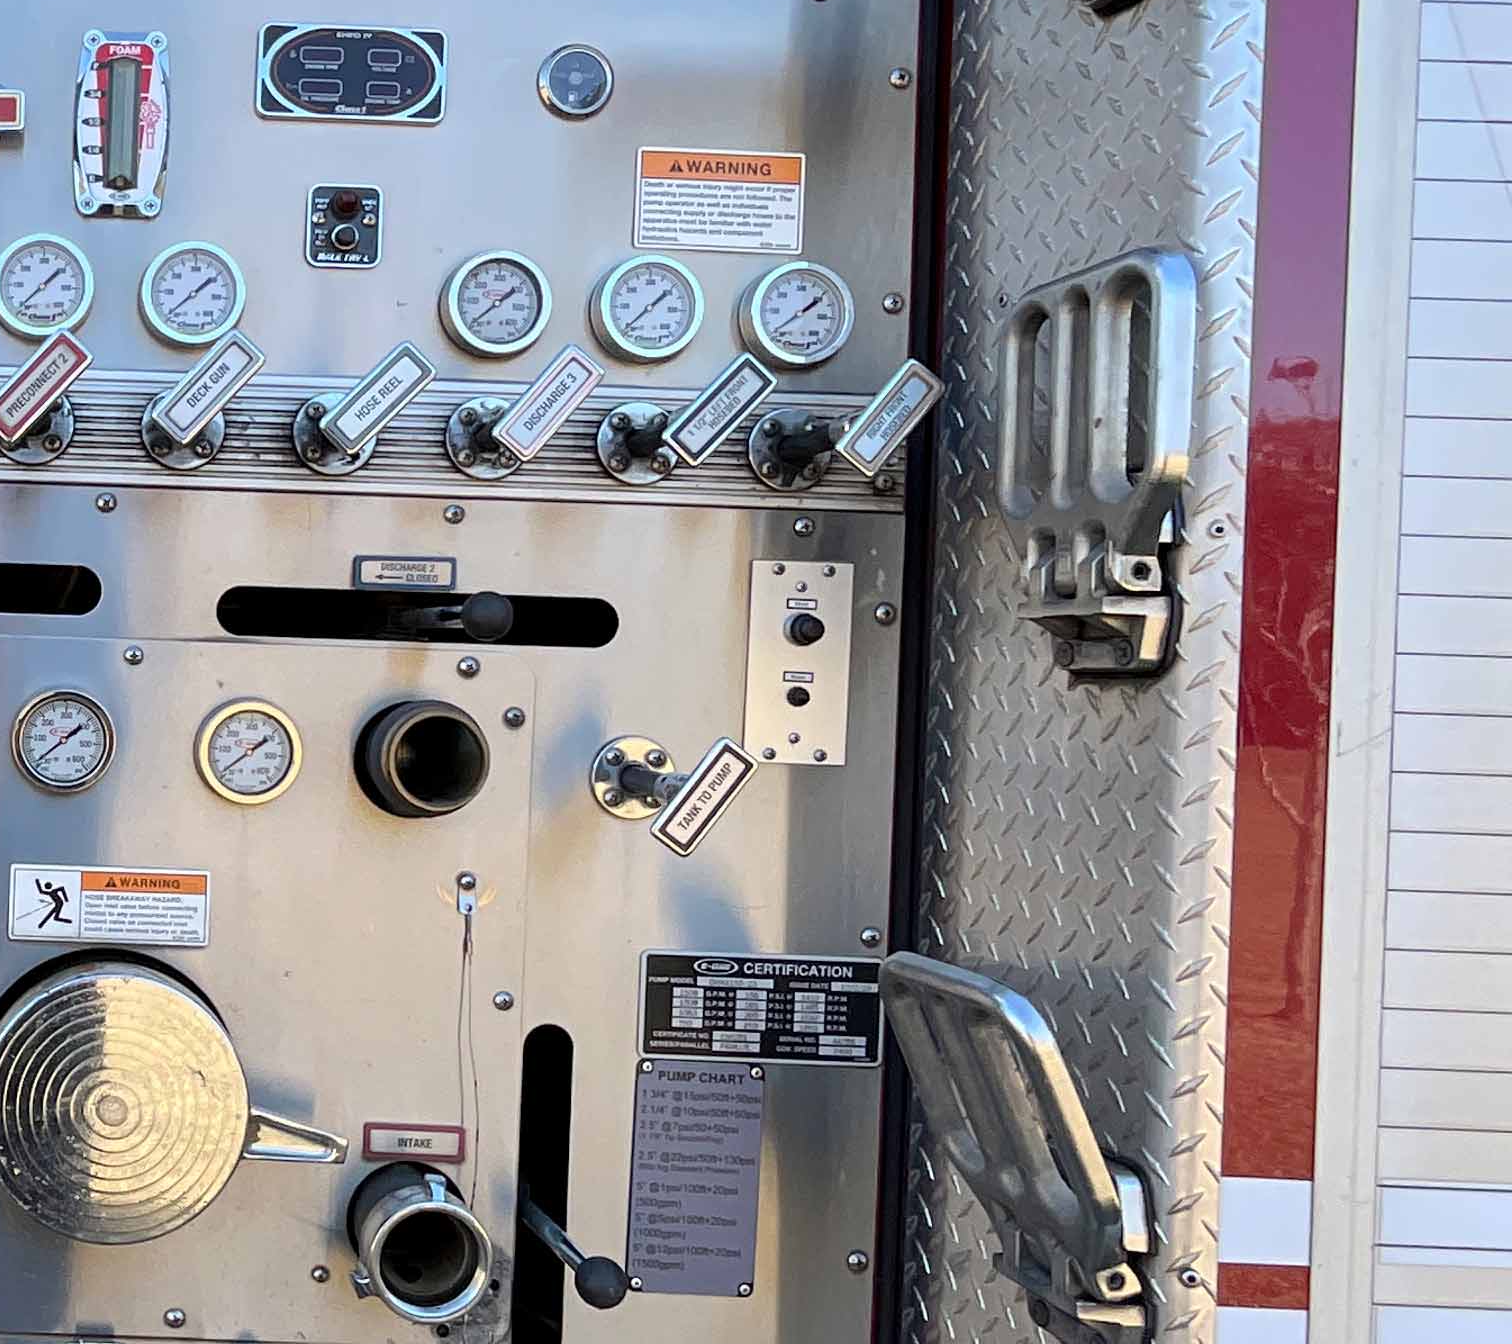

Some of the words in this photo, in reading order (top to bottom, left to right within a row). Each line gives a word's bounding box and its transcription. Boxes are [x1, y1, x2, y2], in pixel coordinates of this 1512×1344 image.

[109, 45, 141, 56] FOAM
[687, 159, 772, 177] WARNING
[6, 363, 61, 418] PRECONNECT
[186, 380, 212, 409] DECK
[207, 362, 231, 386] GUN
[354, 395, 382, 422] HOSE
[378, 375, 404, 399] REEL
[707, 393, 729, 418] LEFT
[724, 375, 749, 400] FRONT
[523, 381, 574, 431] DISCHARGE
[709, 396, 742, 431] HOSEBED
[381, 562, 427, 572] DISCHARGE
[406, 573, 439, 583] CLOSED
[677, 803, 703, 830] TANK
[697, 790, 712, 804] TO
[708, 762, 732, 791] PUMP
[119, 878, 181, 890] WARNING
[743, 963, 853, 978] CERTIFICATION
[658, 1070, 696, 1082] PUMP
[698, 1072, 745, 1085] CHART
[397, 1136, 433, 1150] INTAKE
